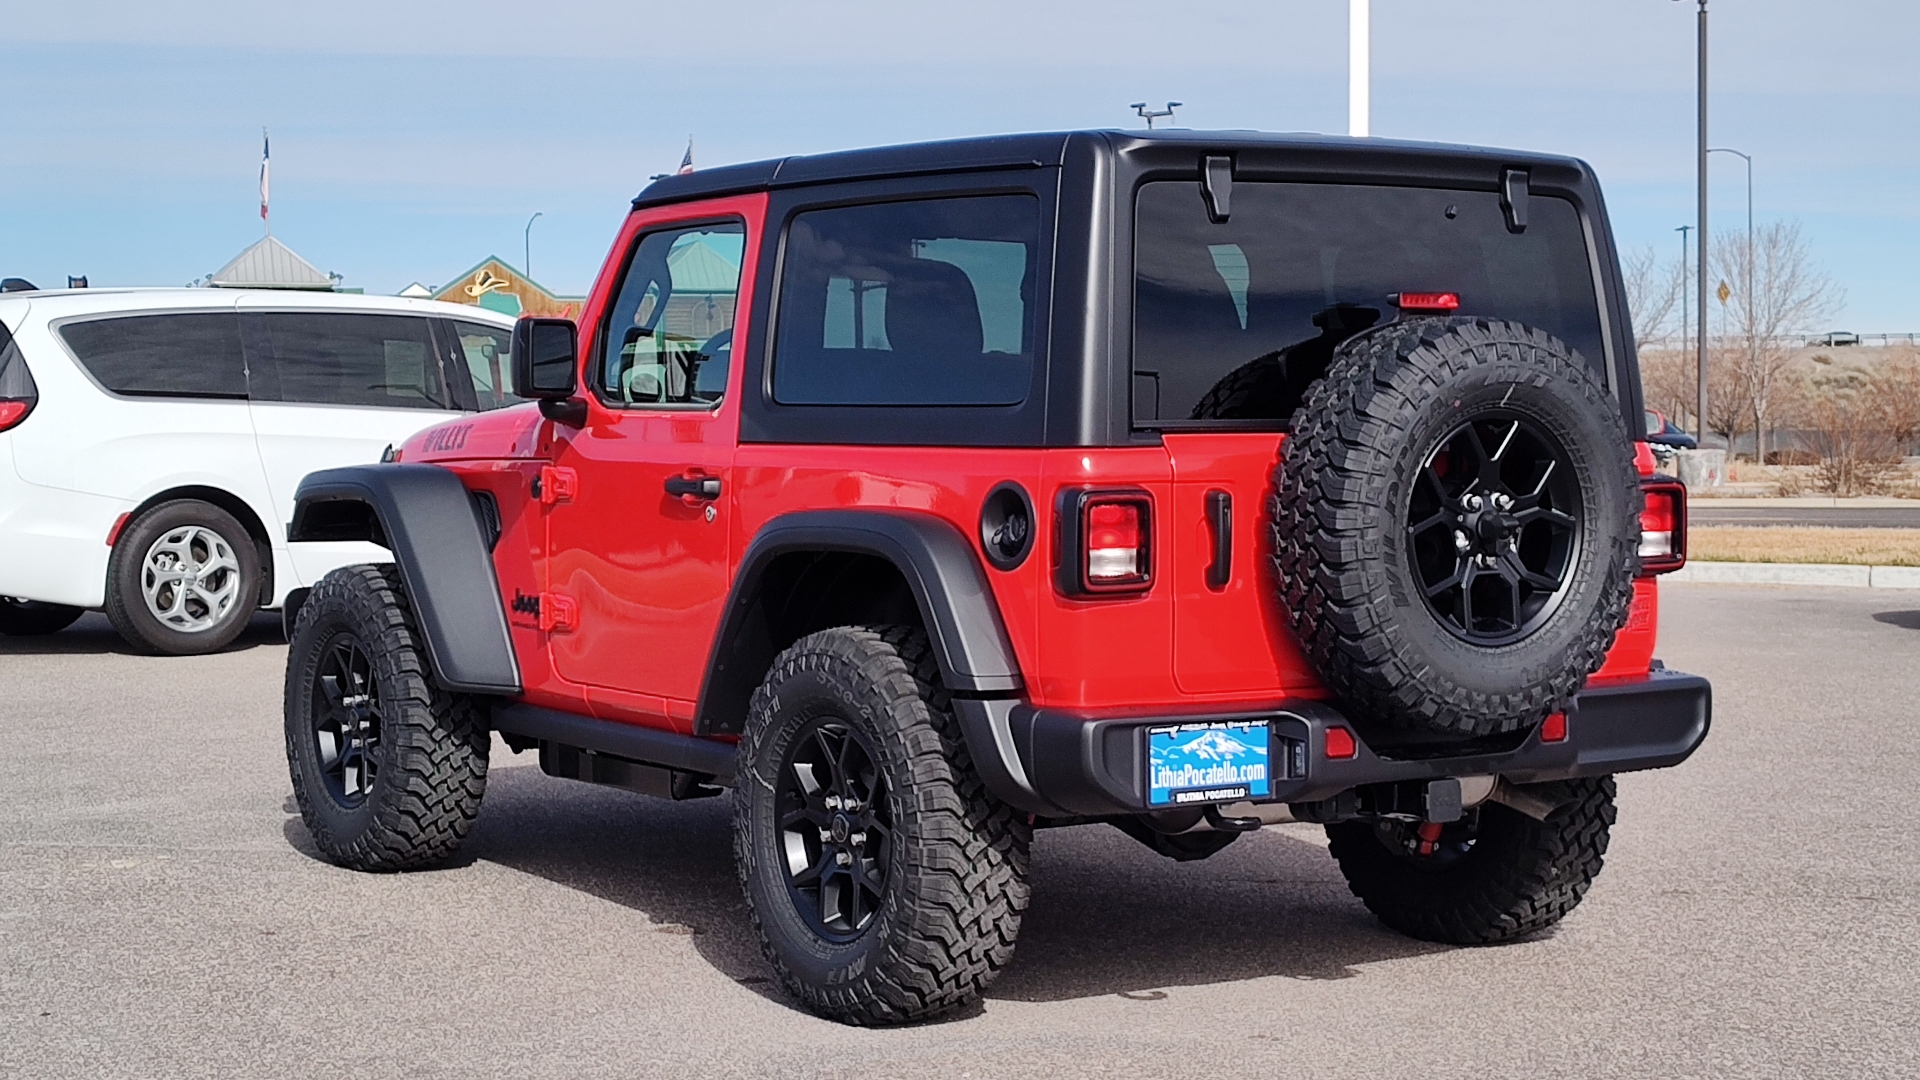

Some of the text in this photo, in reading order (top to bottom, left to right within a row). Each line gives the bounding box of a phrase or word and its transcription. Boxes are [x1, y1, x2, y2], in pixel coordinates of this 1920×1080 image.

[422, 424, 475, 453] WILLYS
[1150, 760, 1265, 789] LithiaPocatello.com
[1205, 788, 1246, 801] POCATELLO
